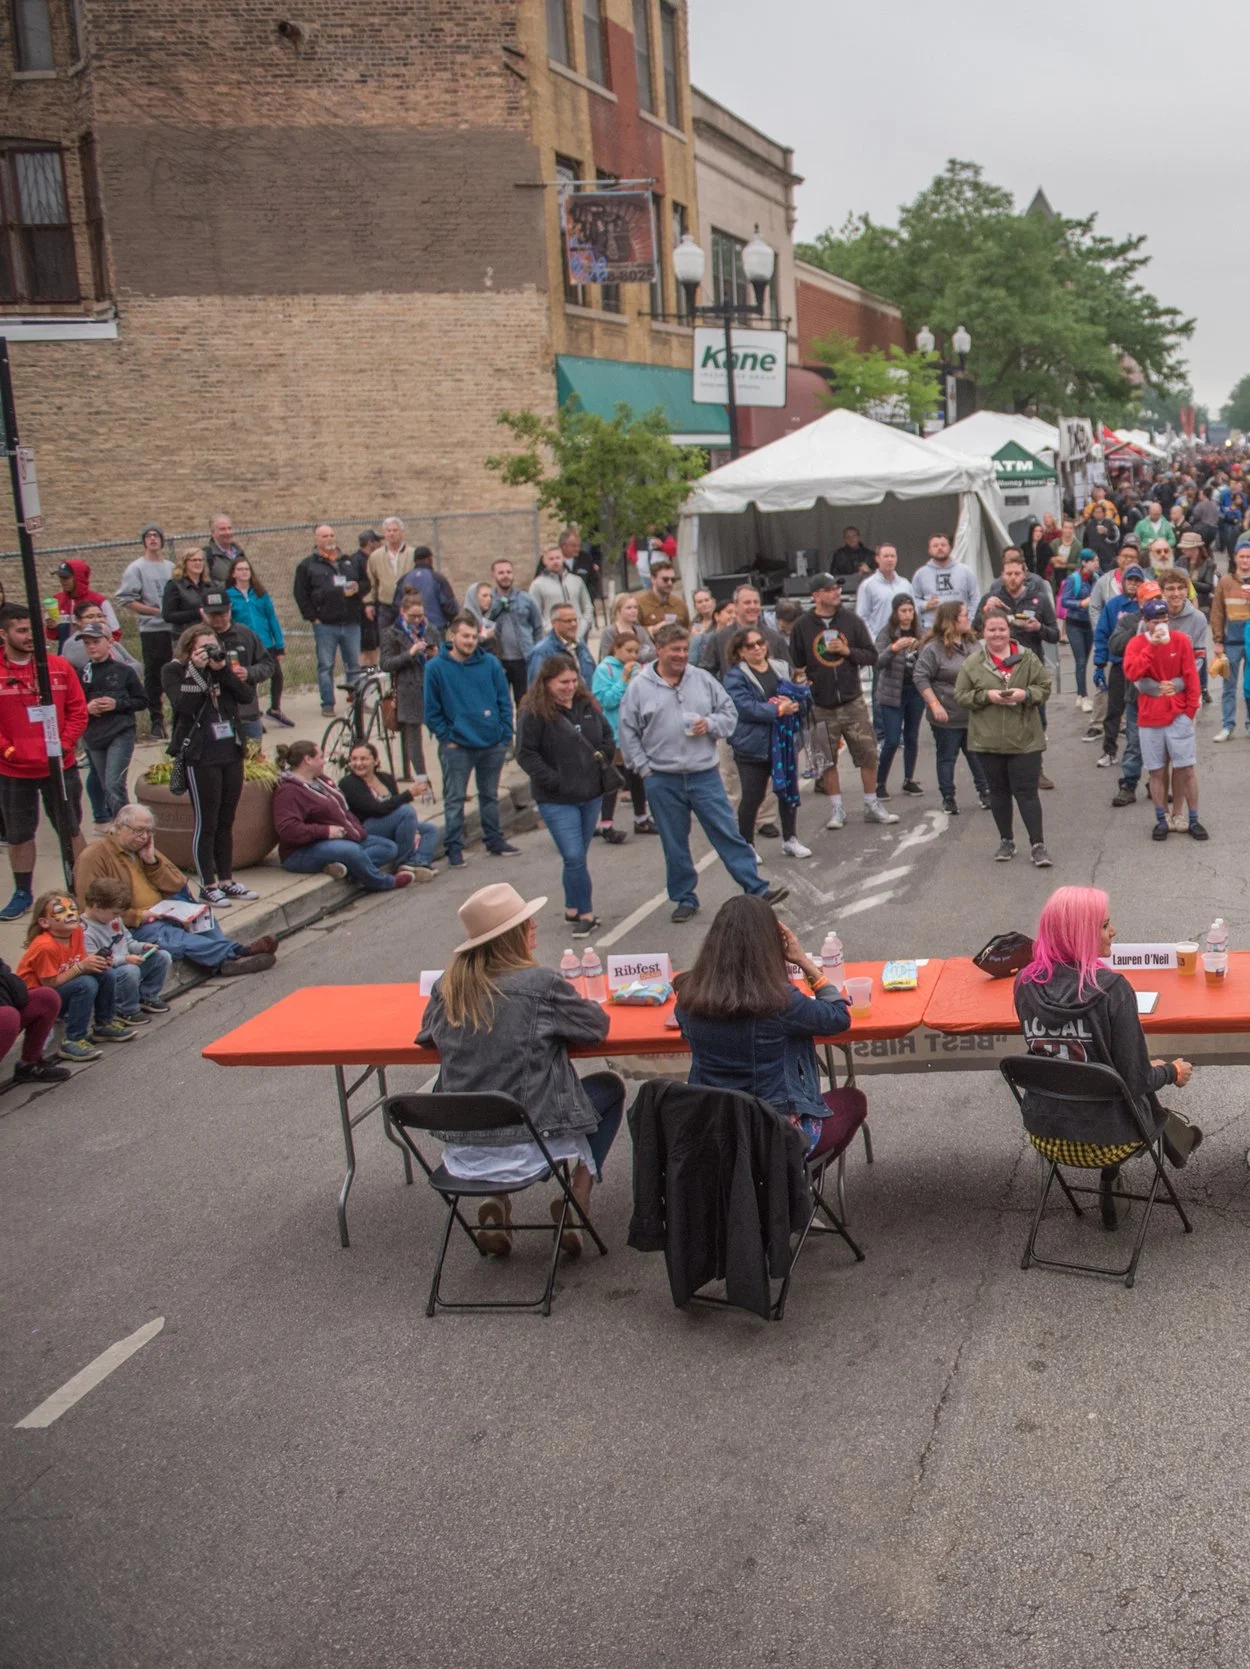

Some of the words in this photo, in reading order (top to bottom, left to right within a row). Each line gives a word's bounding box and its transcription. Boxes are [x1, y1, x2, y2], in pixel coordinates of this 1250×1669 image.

[993, 460, 1034, 472] ATM
[1112, 955, 1142, 965] Lauren
[1144, 953, 1169, 965] O'Neil
[614, 962, 660, 977] Ribfest
